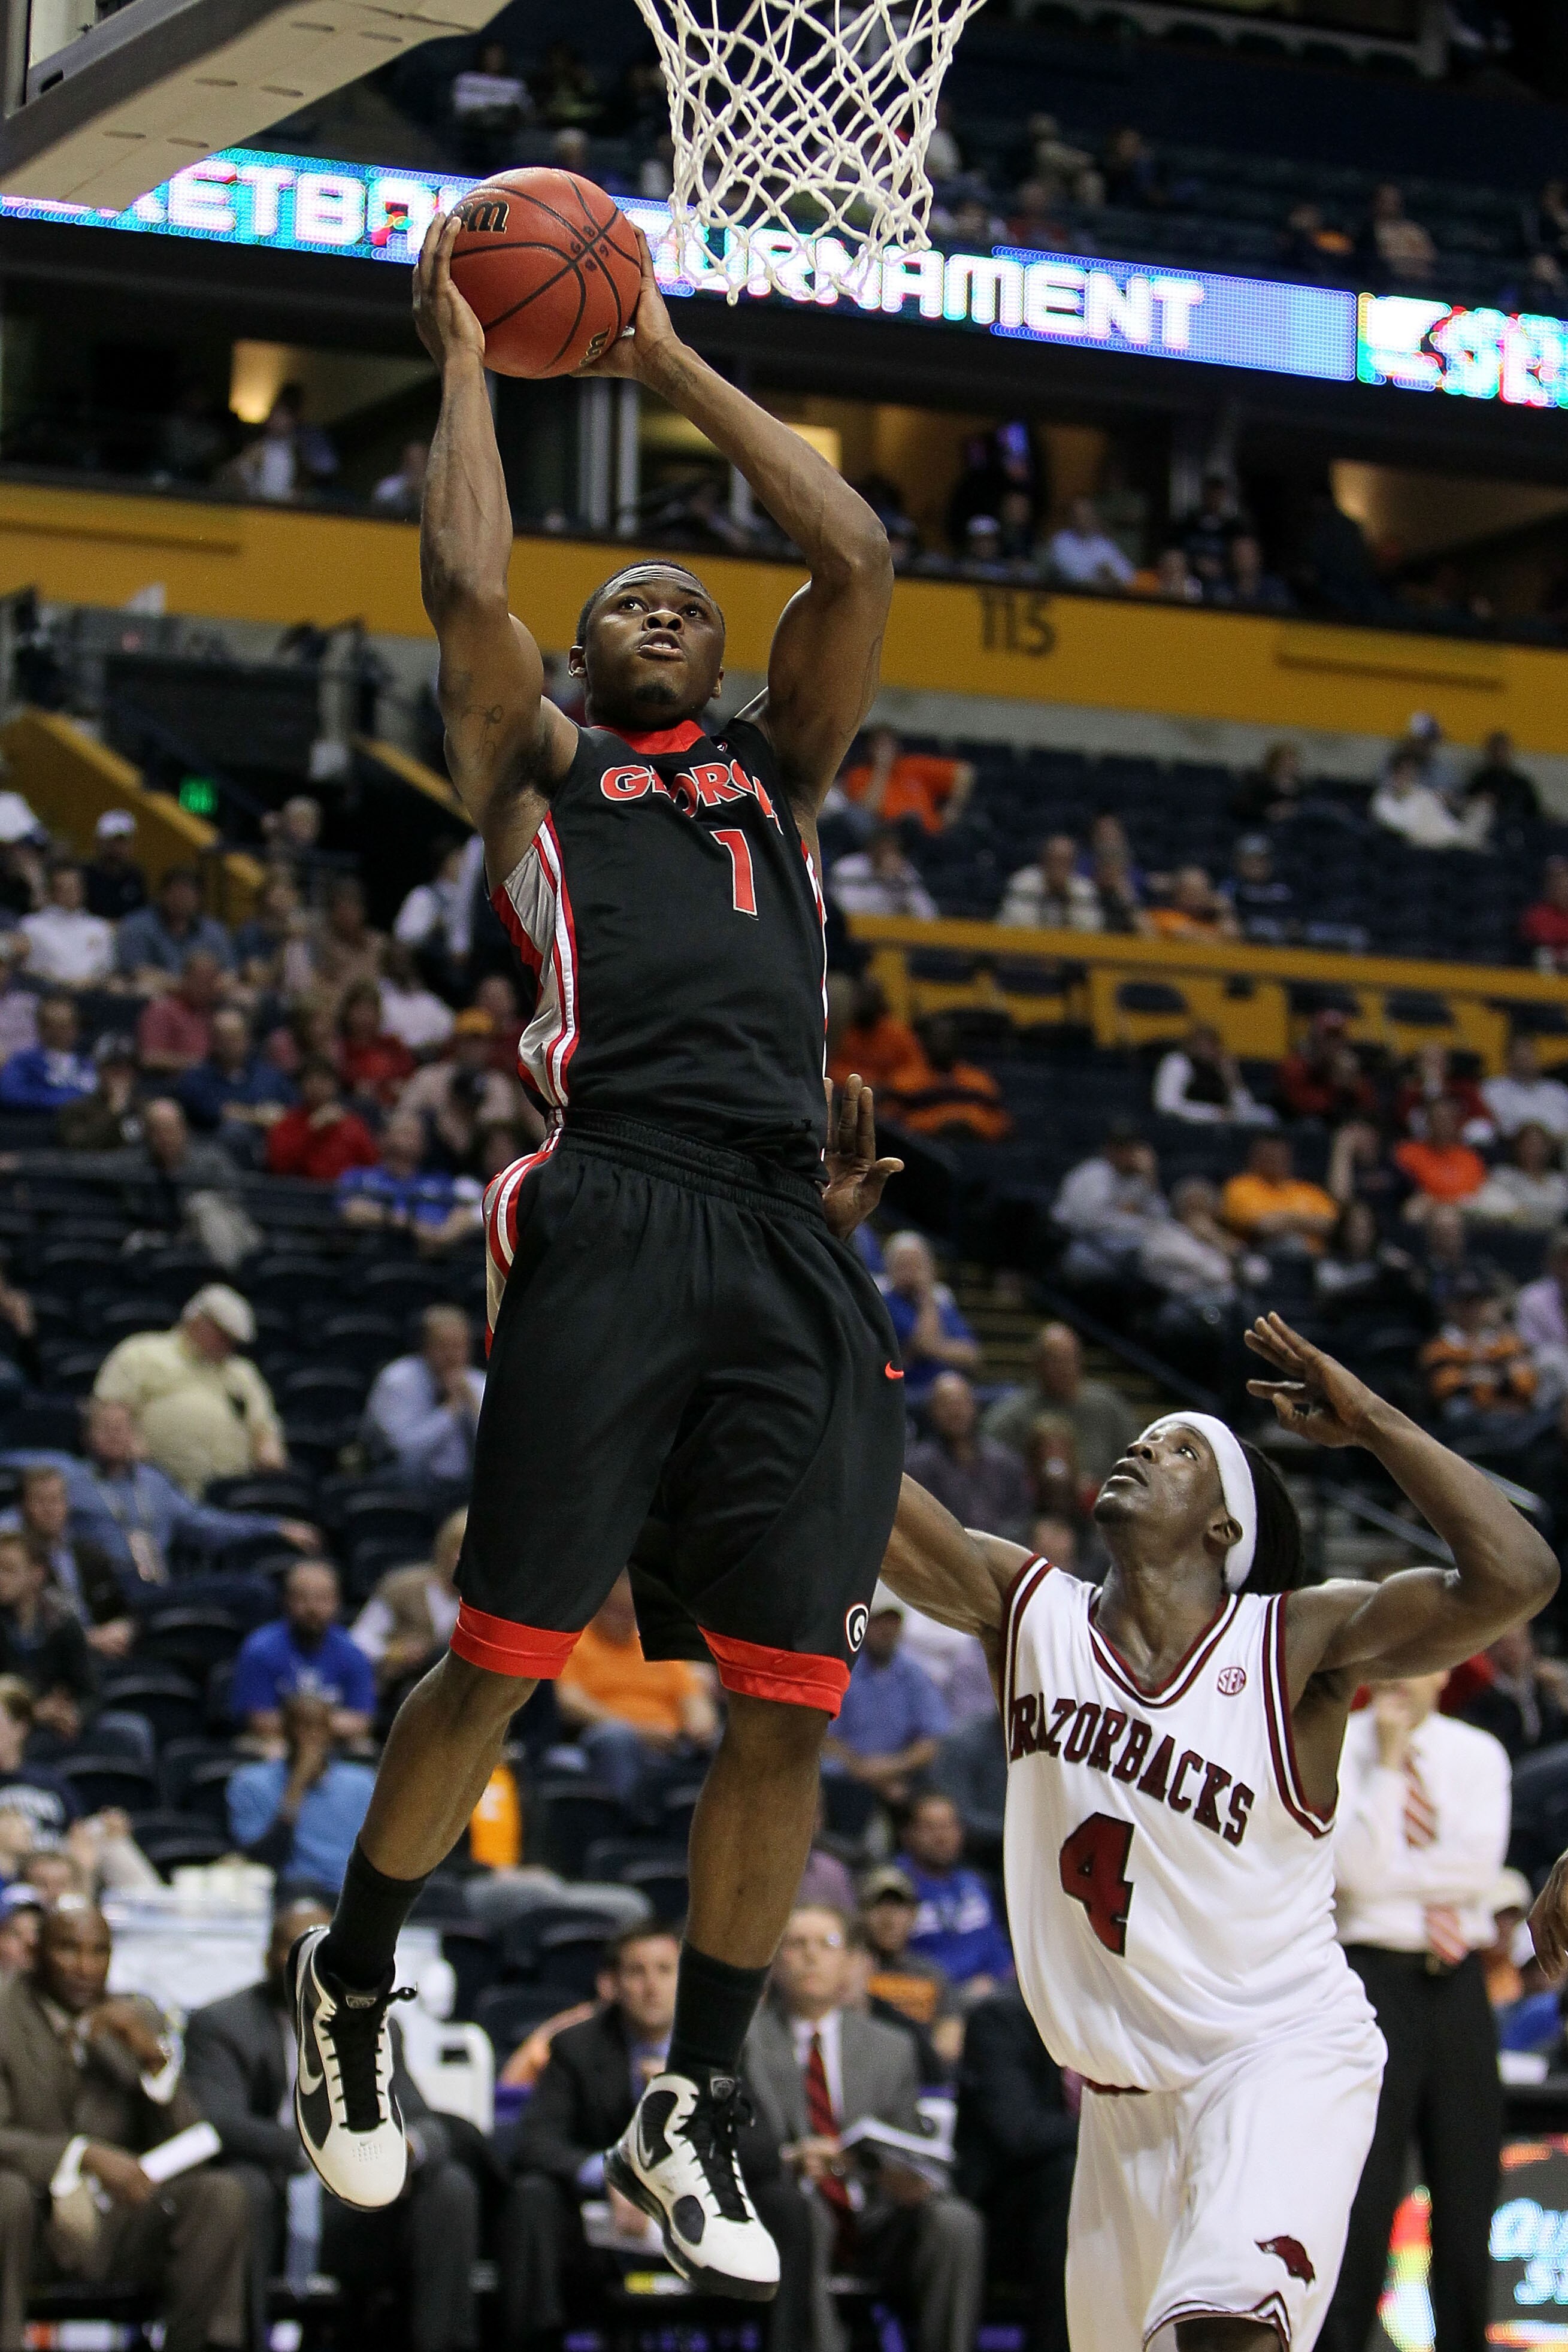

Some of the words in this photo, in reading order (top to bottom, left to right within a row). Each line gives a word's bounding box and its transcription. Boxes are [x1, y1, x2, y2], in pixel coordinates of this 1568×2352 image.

[980, 588, 1055, 657] 115
[709, 829, 757, 916] 1
[846, 1604, 868, 1652] G
[1218, 1668, 1245, 1694] SEC
[1059, 1812, 1135, 1957] 4
